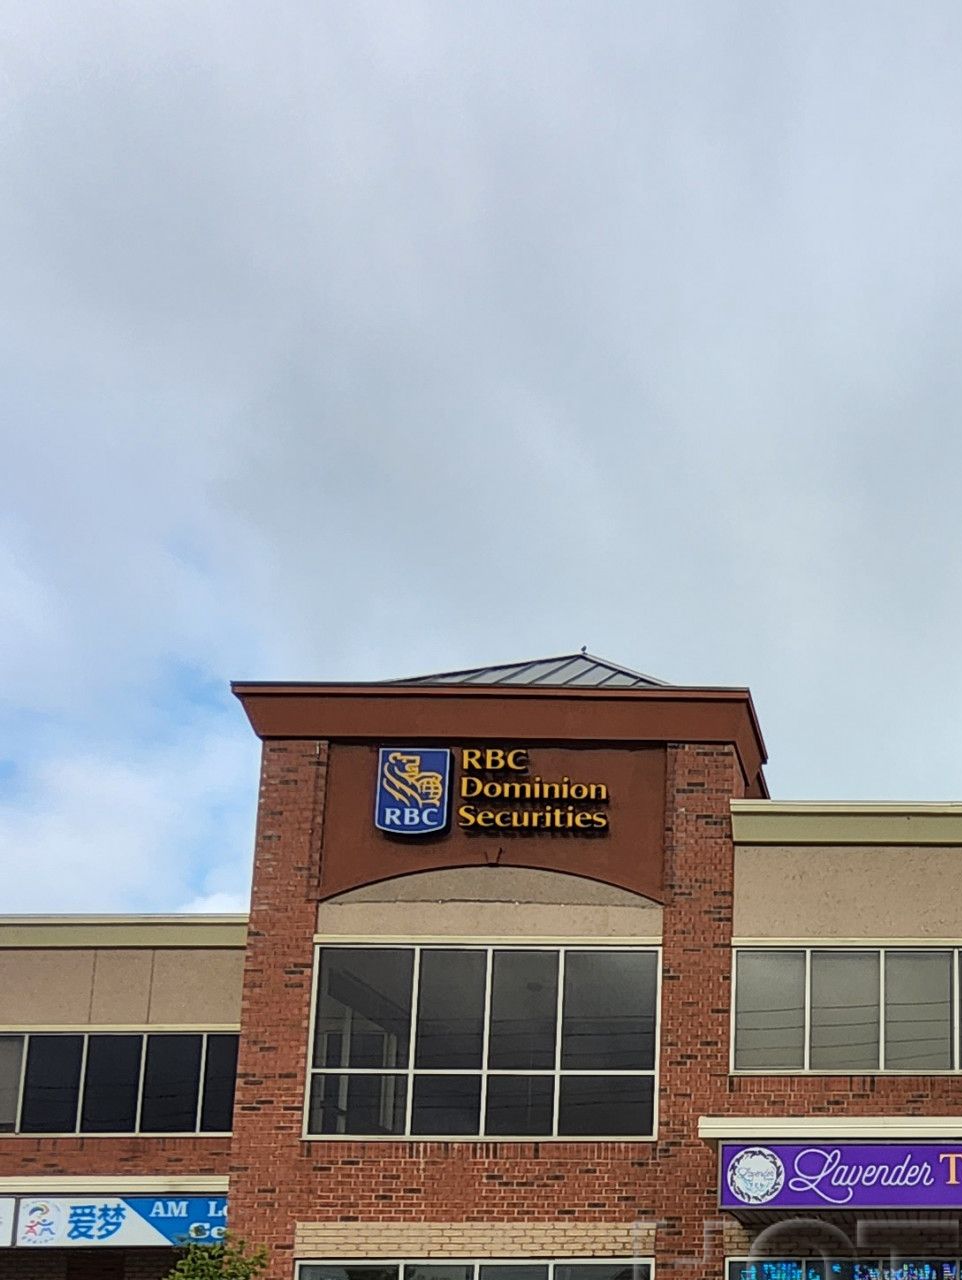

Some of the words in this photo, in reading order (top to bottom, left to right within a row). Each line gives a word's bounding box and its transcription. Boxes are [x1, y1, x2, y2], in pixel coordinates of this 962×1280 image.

[462, 749, 527, 770] RBC
[460, 777, 608, 799] Dominion
[384, 808, 438, 826] RBC
[458, 805, 608, 828] Securities
[788, 1148, 934, 1204] Lavender
[149, 1201, 189, 1217] AM
[67, 1203, 126, 1241] 爱梦
